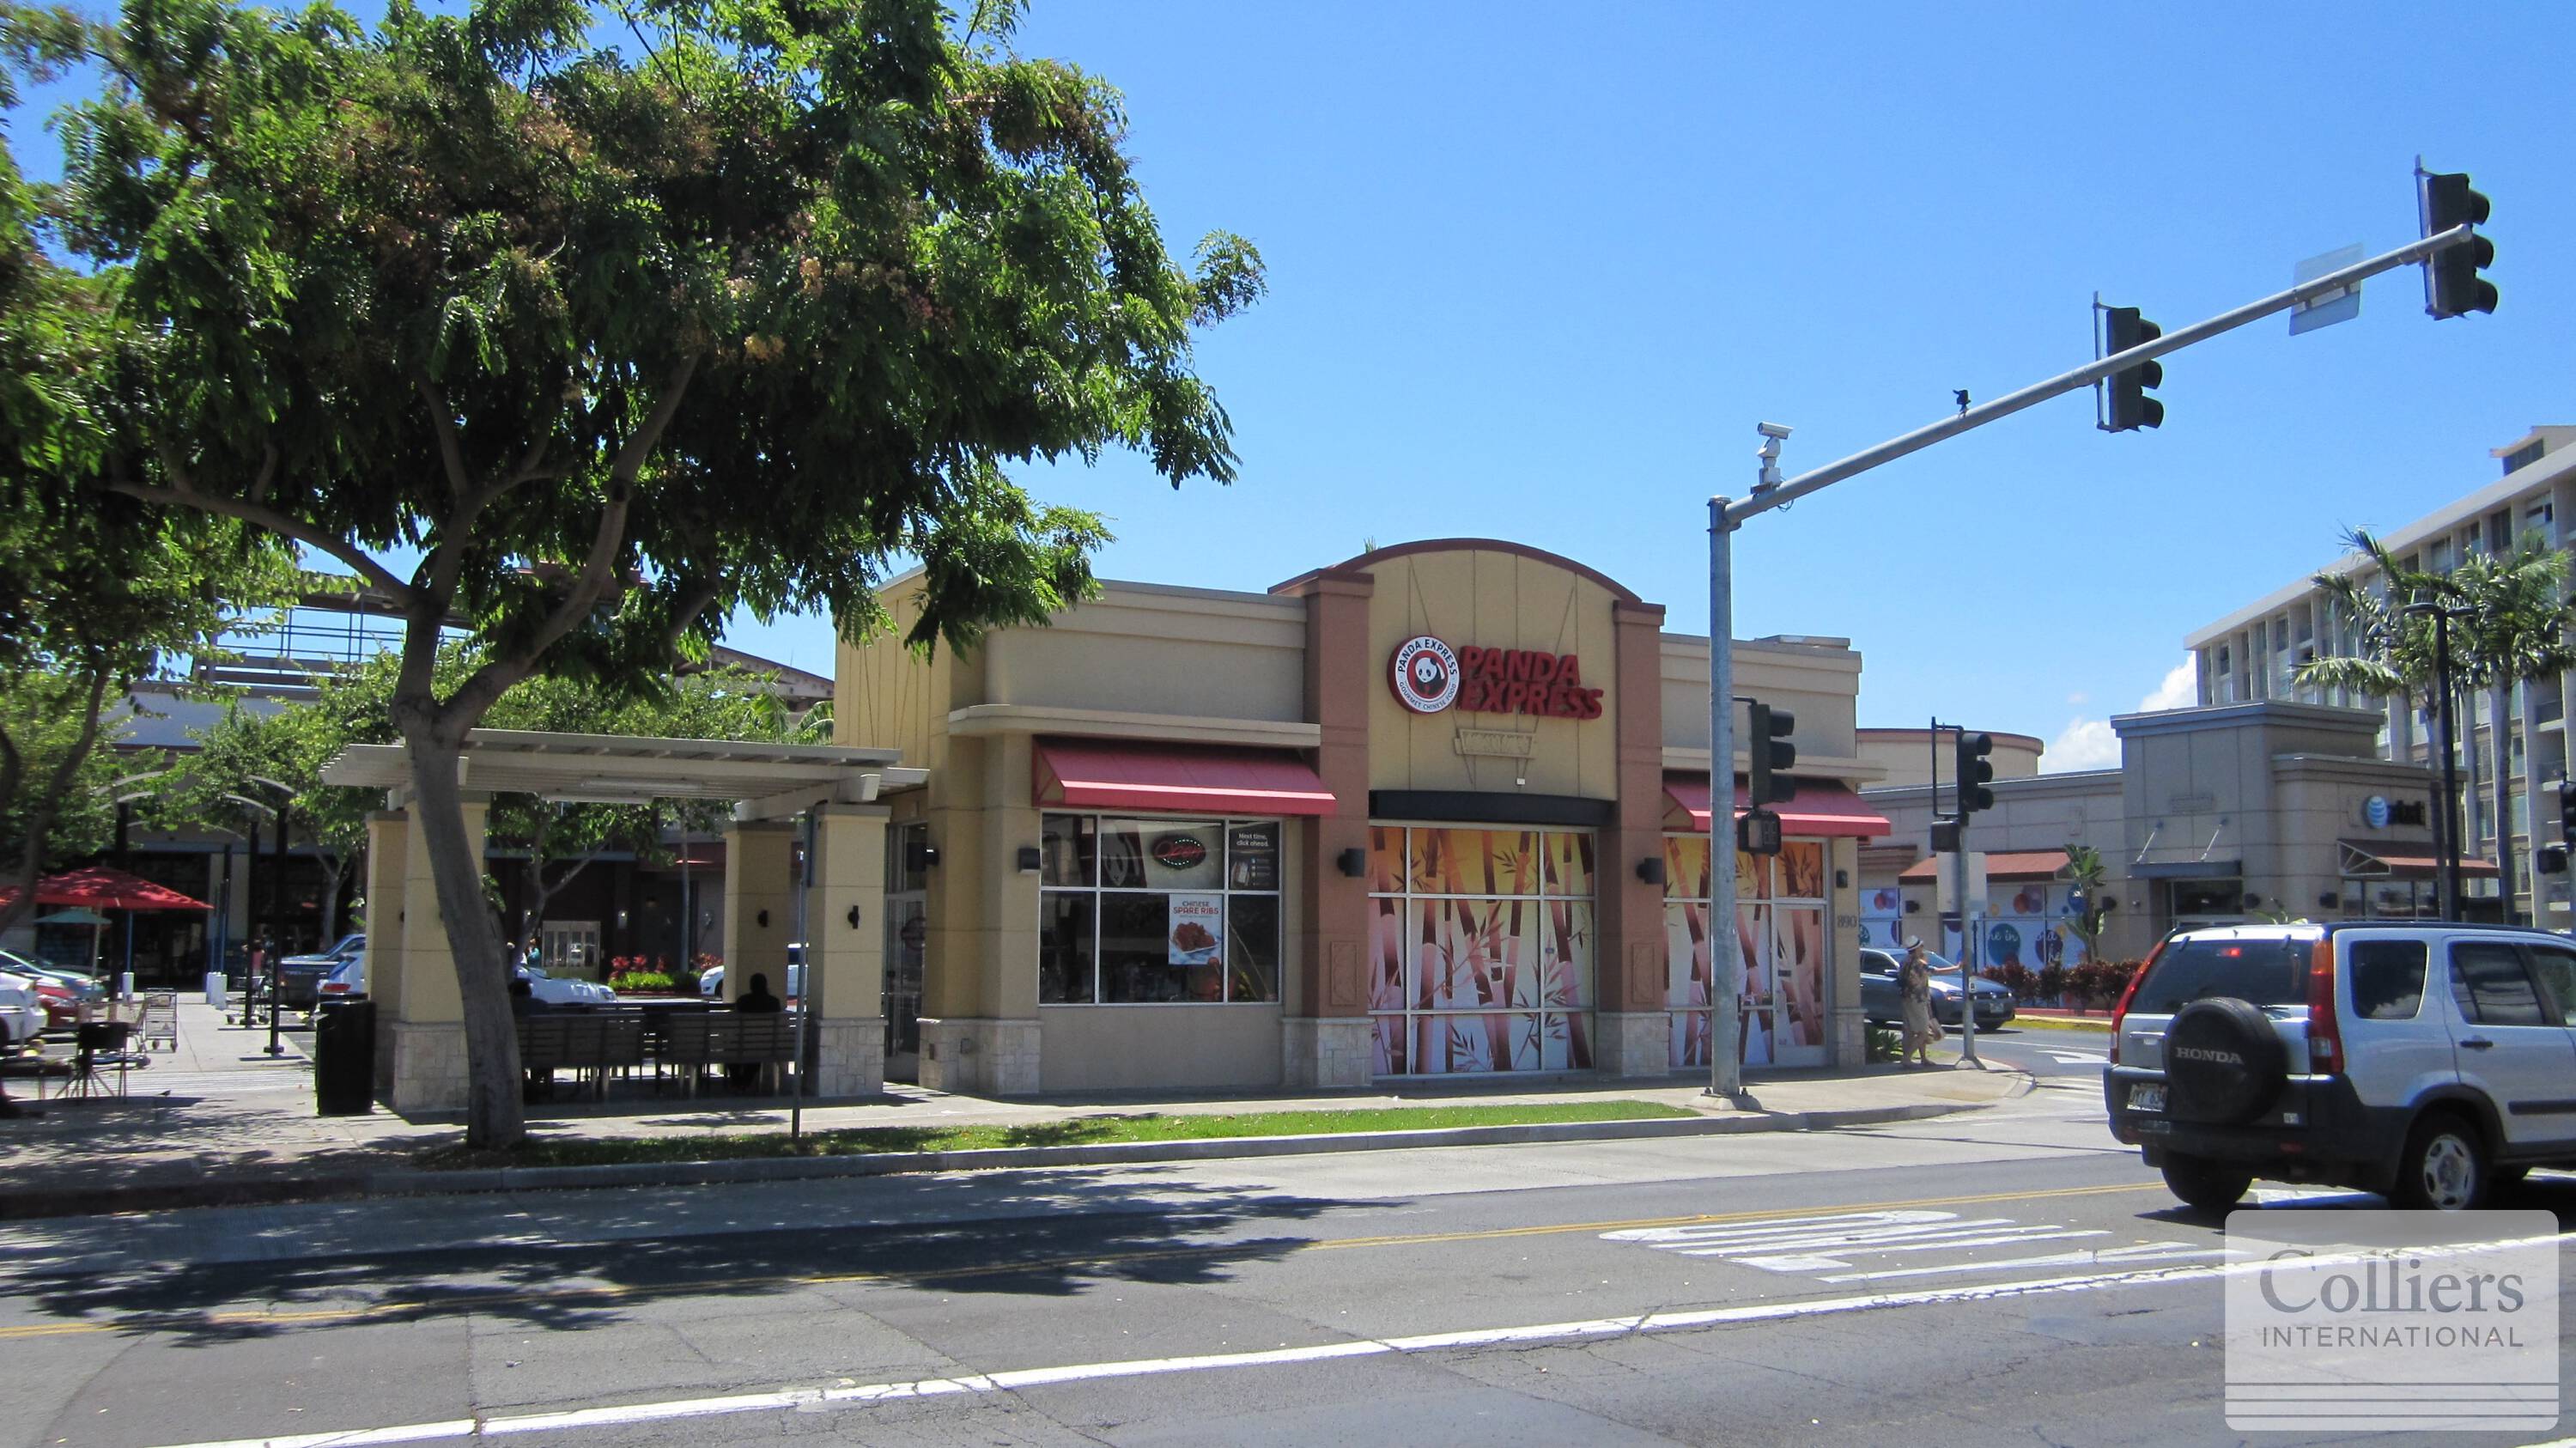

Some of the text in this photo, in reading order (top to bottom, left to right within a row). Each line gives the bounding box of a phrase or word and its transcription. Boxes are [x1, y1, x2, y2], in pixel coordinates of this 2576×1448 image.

[1398, 639, 1458, 675] PANDA EXPRESS
[1461, 646, 1581, 686] PANDA
[1399, 681, 1457, 711] GOURMET CHINESE FOOD
[1457, 679, 1604, 720] EXPRESS
[2175, 1047, 2244, 1065] HONDA
